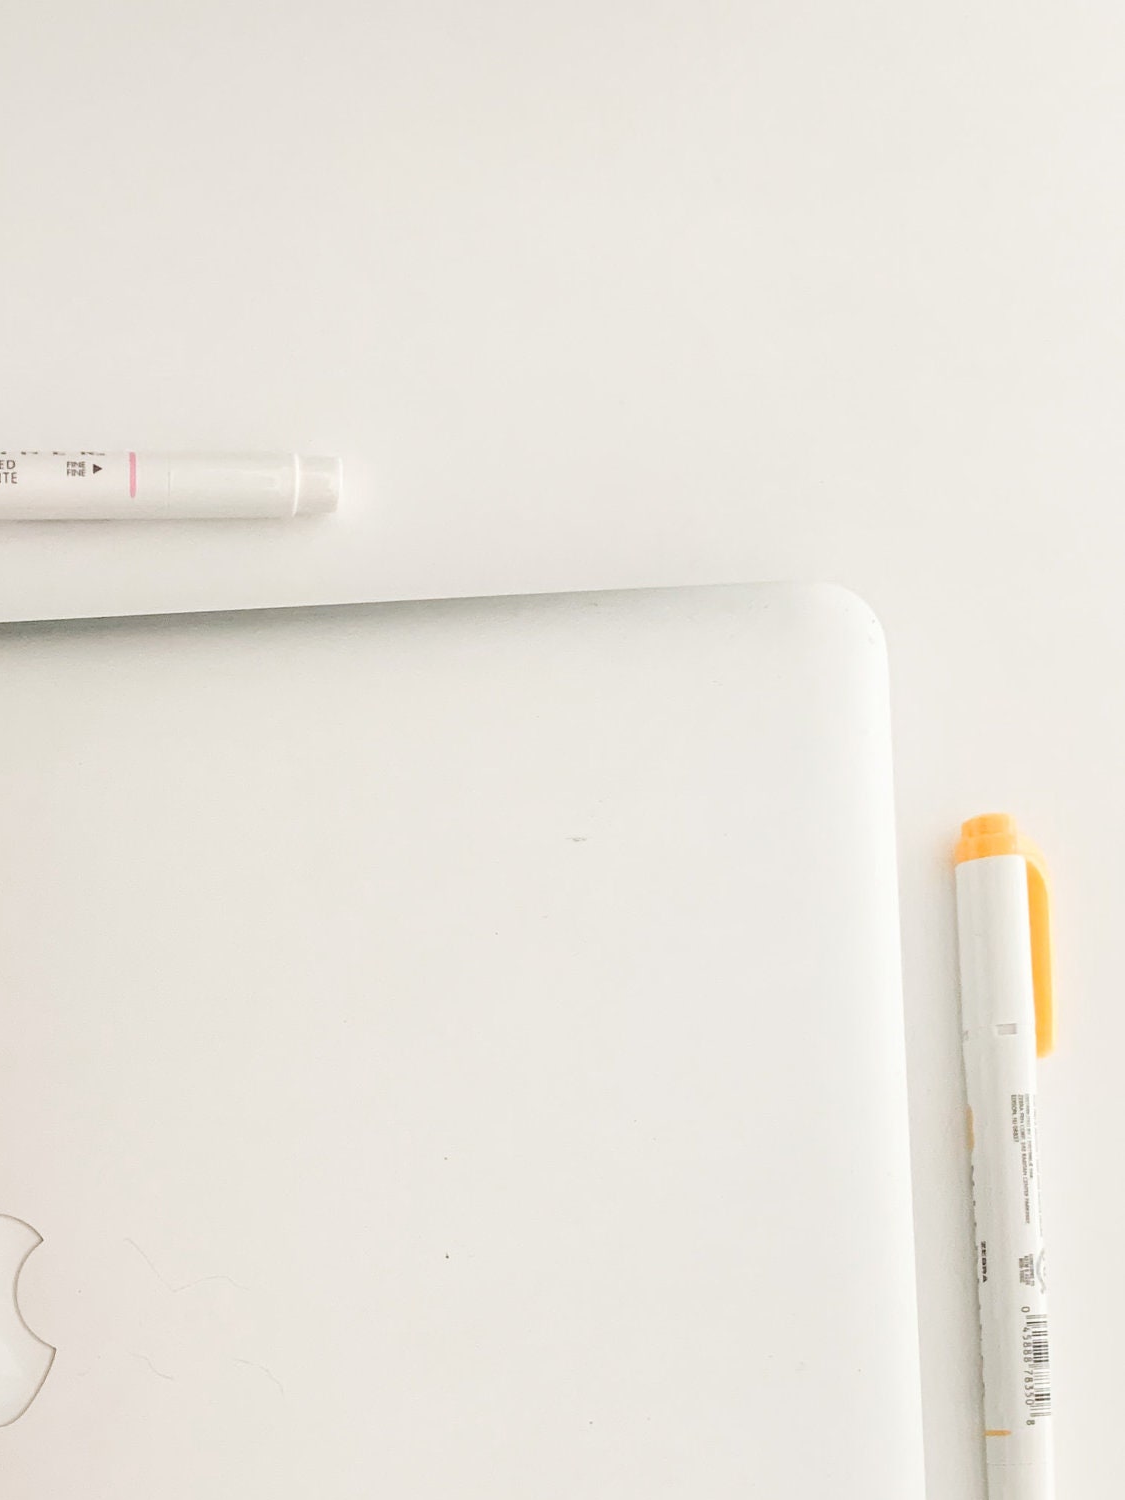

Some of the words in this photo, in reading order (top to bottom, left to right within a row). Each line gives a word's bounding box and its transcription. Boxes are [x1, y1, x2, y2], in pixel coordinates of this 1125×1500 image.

[66, 468, 86, 477] FINE
[1022, 1327, 1032, 1363] 45888
[1023, 1370, 1034, 1405] 78350
